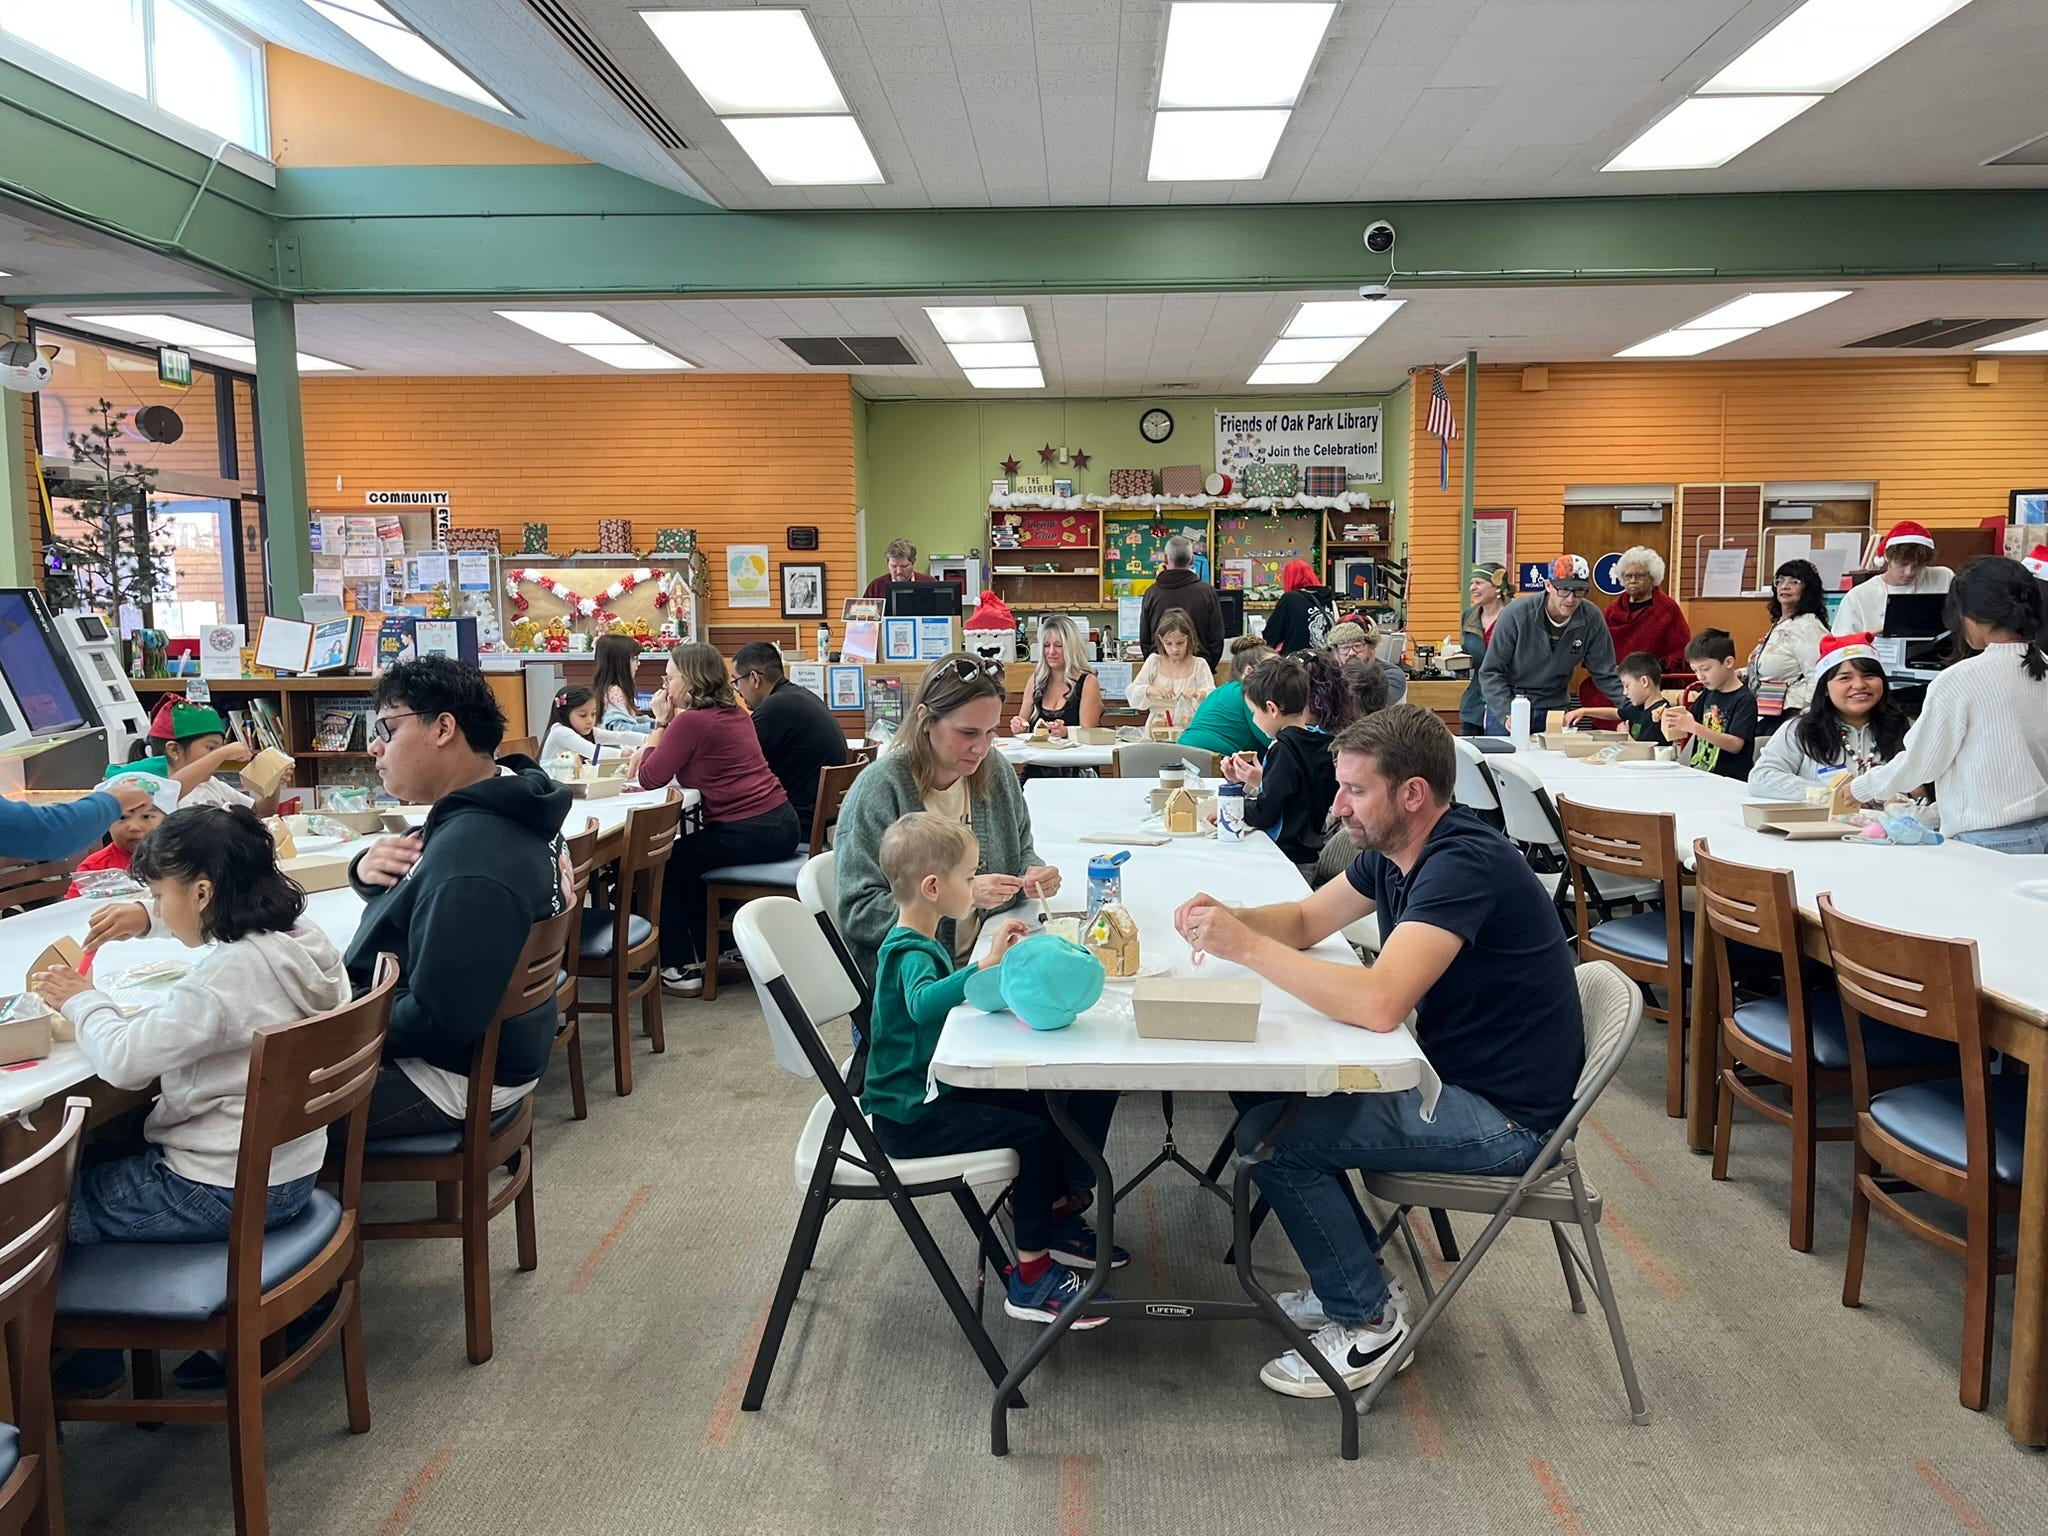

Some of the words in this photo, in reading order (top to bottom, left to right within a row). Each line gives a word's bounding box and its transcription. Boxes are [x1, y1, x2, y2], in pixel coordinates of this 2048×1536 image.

[166, 351, 189, 381] EXIT
[1220, 414, 1262, 433] Friends
[1265, 414, 1277, 431] of
[1281, 414, 1304, 432] Oak
[1307, 413, 1334, 431] Park
[1337, 412, 1378, 433] Library
[1267, 445, 1290, 458] Join
[1293, 444, 1310, 457] the
[1313, 442, 1378, 456] Celebration!
[1027, 477, 1040, 485] THE
[369, 492, 448, 504] COMMUNITY
[1034, 529, 1057, 541] Club
[1256, 572, 1282, 583] MAK
[1152, 1306, 1188, 1315] LIFETIME
